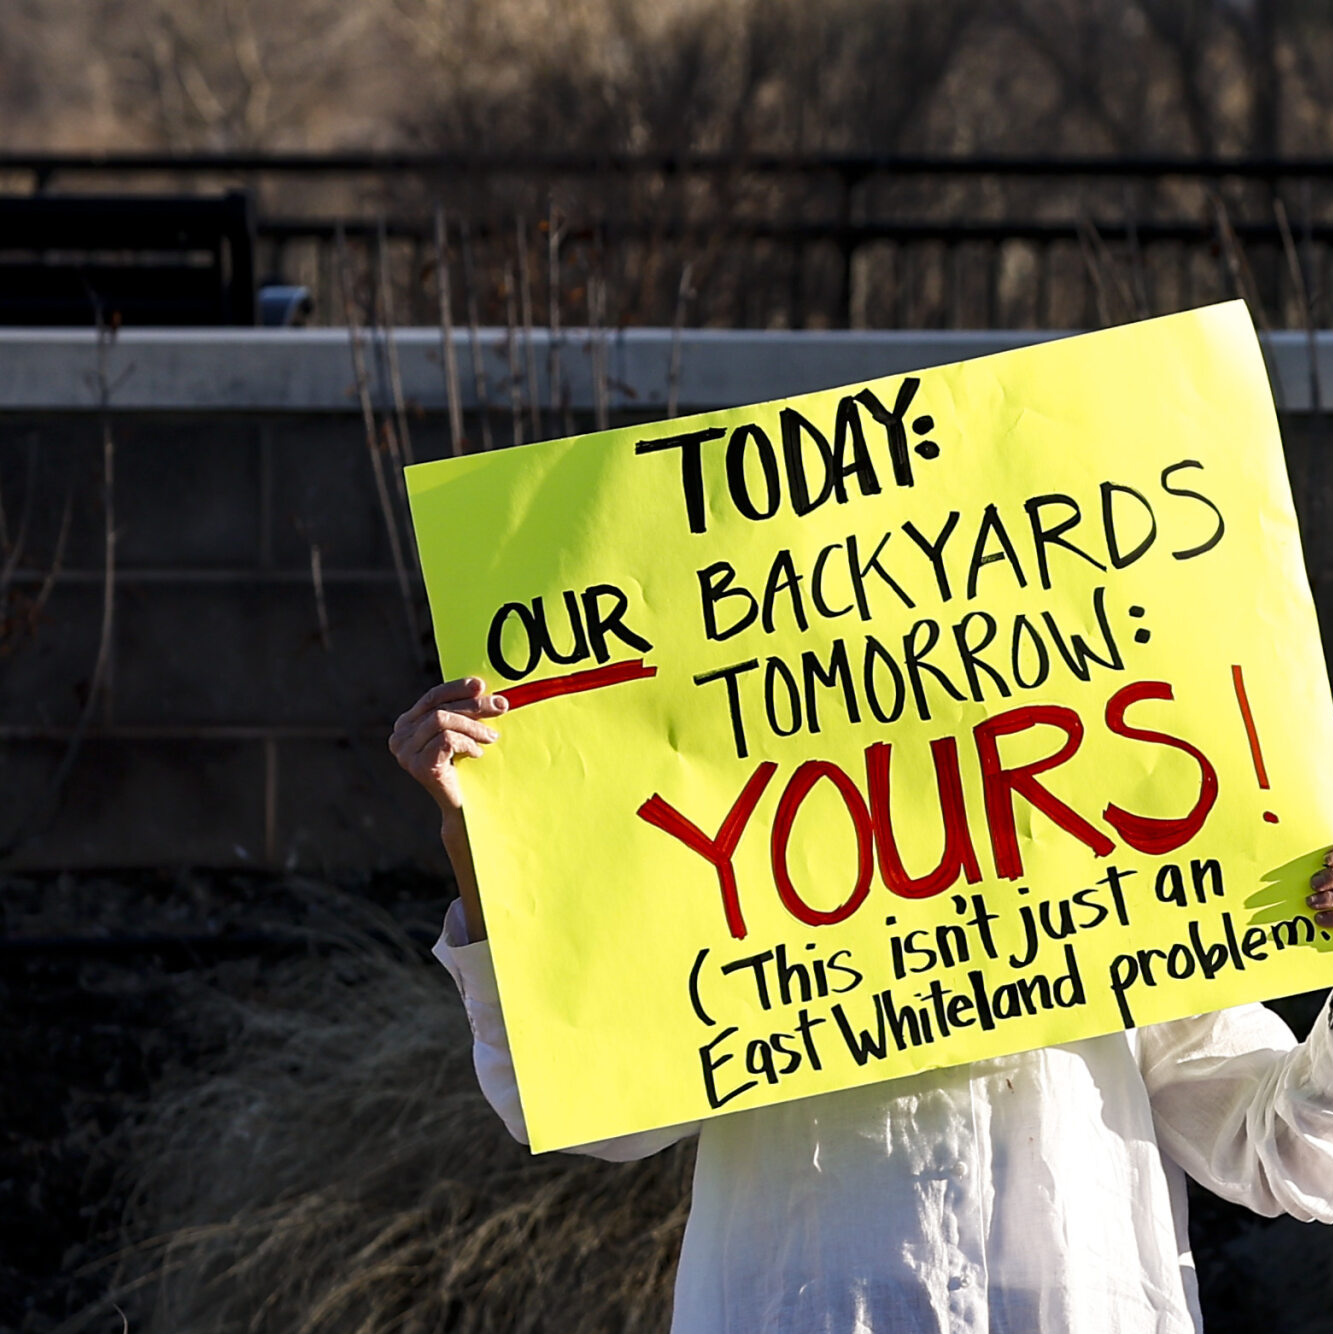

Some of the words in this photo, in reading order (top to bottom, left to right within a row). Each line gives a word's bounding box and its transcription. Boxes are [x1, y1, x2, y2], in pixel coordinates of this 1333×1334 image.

[634, 376, 940, 535] TODAY:
[487, 584, 654, 681] OUR
[697, 458, 1225, 643] BACKYARDS
[694, 586, 1152, 758] TOMORROW:
[637, 663, 1281, 941] YOURS!
[689, 943, 863, 1026] (This
[886, 894, 1000, 980] isn't
[1008, 866, 1138, 968] just
[1155, 855, 1224, 909] an
[699, 1009, 826, 1109] East
[831, 943, 1086, 1066] Whiteland
